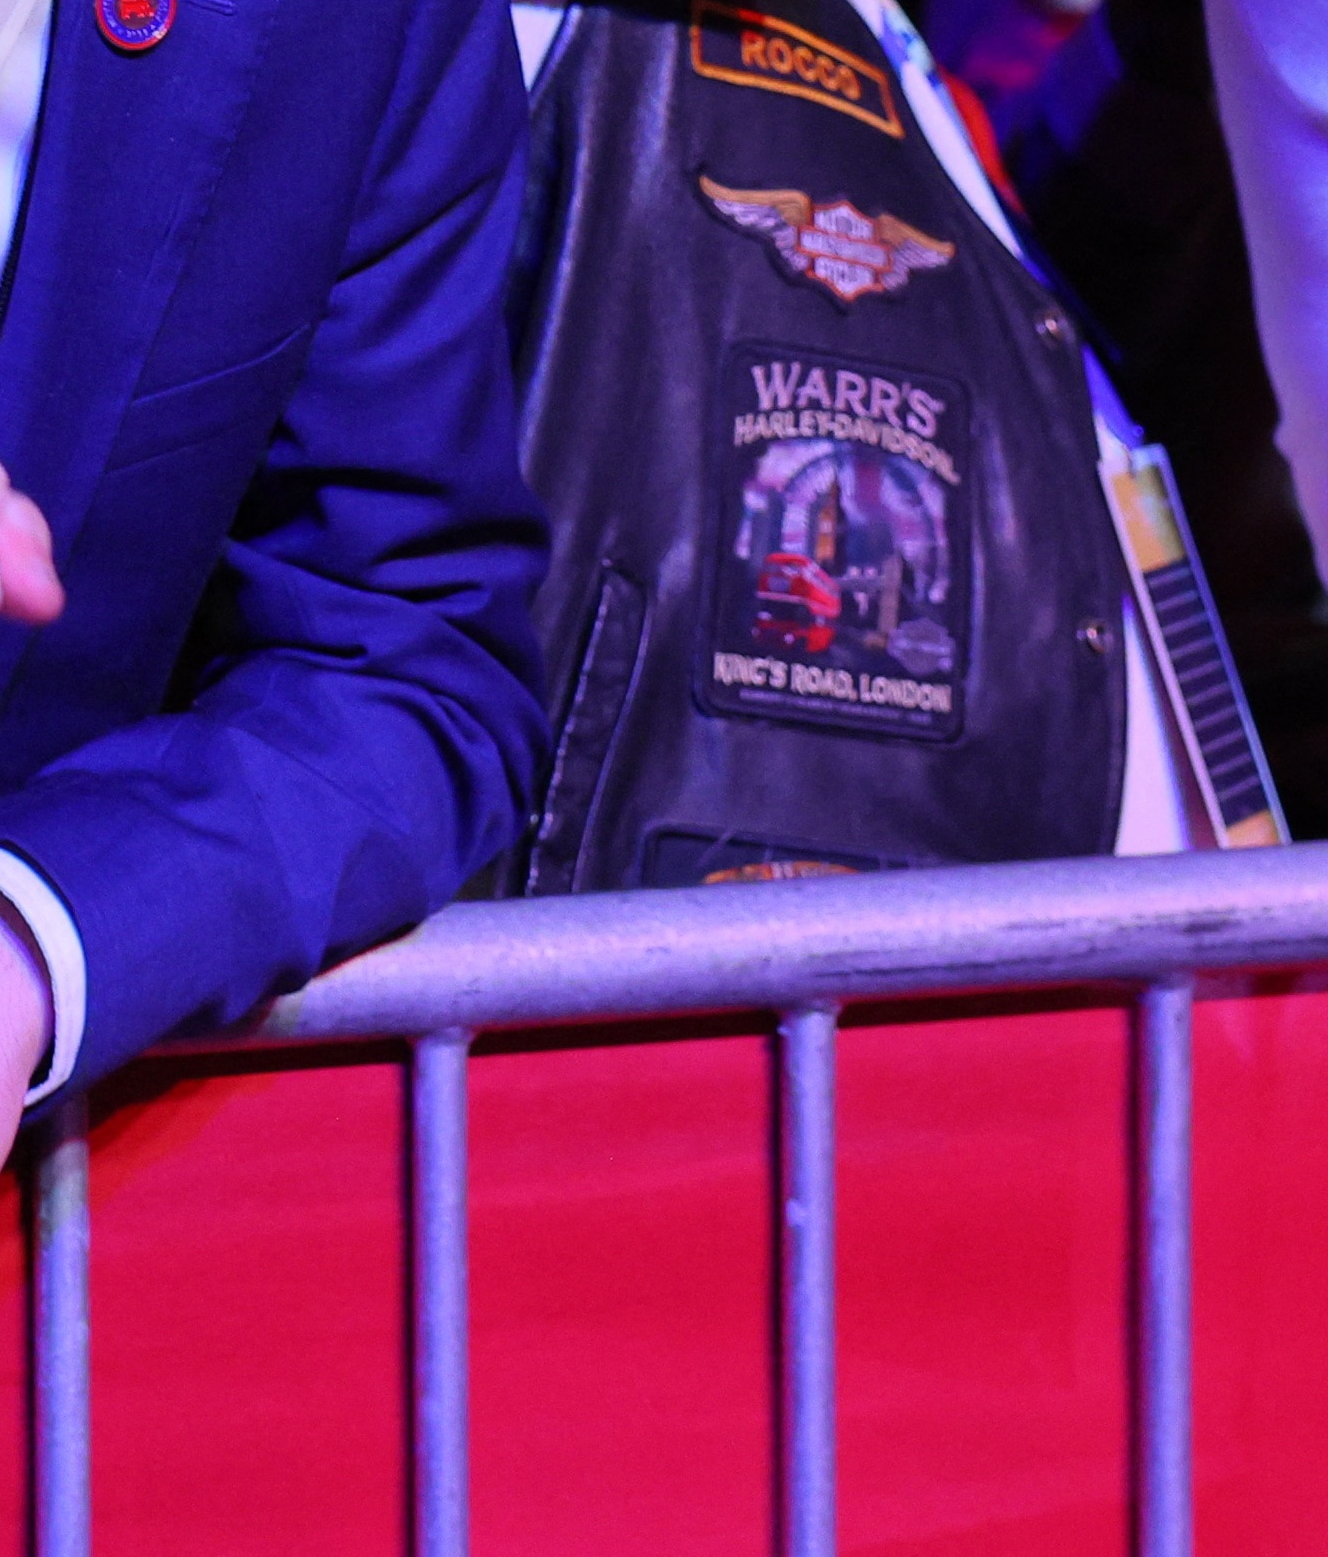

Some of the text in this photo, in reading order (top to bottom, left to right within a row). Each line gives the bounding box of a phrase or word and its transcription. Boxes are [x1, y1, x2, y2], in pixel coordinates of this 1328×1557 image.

[741, 30, 862, 101] ROCCO
[751, 361, 947, 439] WARR'S
[713, 651, 788, 690] KING'S
[860, 672, 953, 714] LONDON
